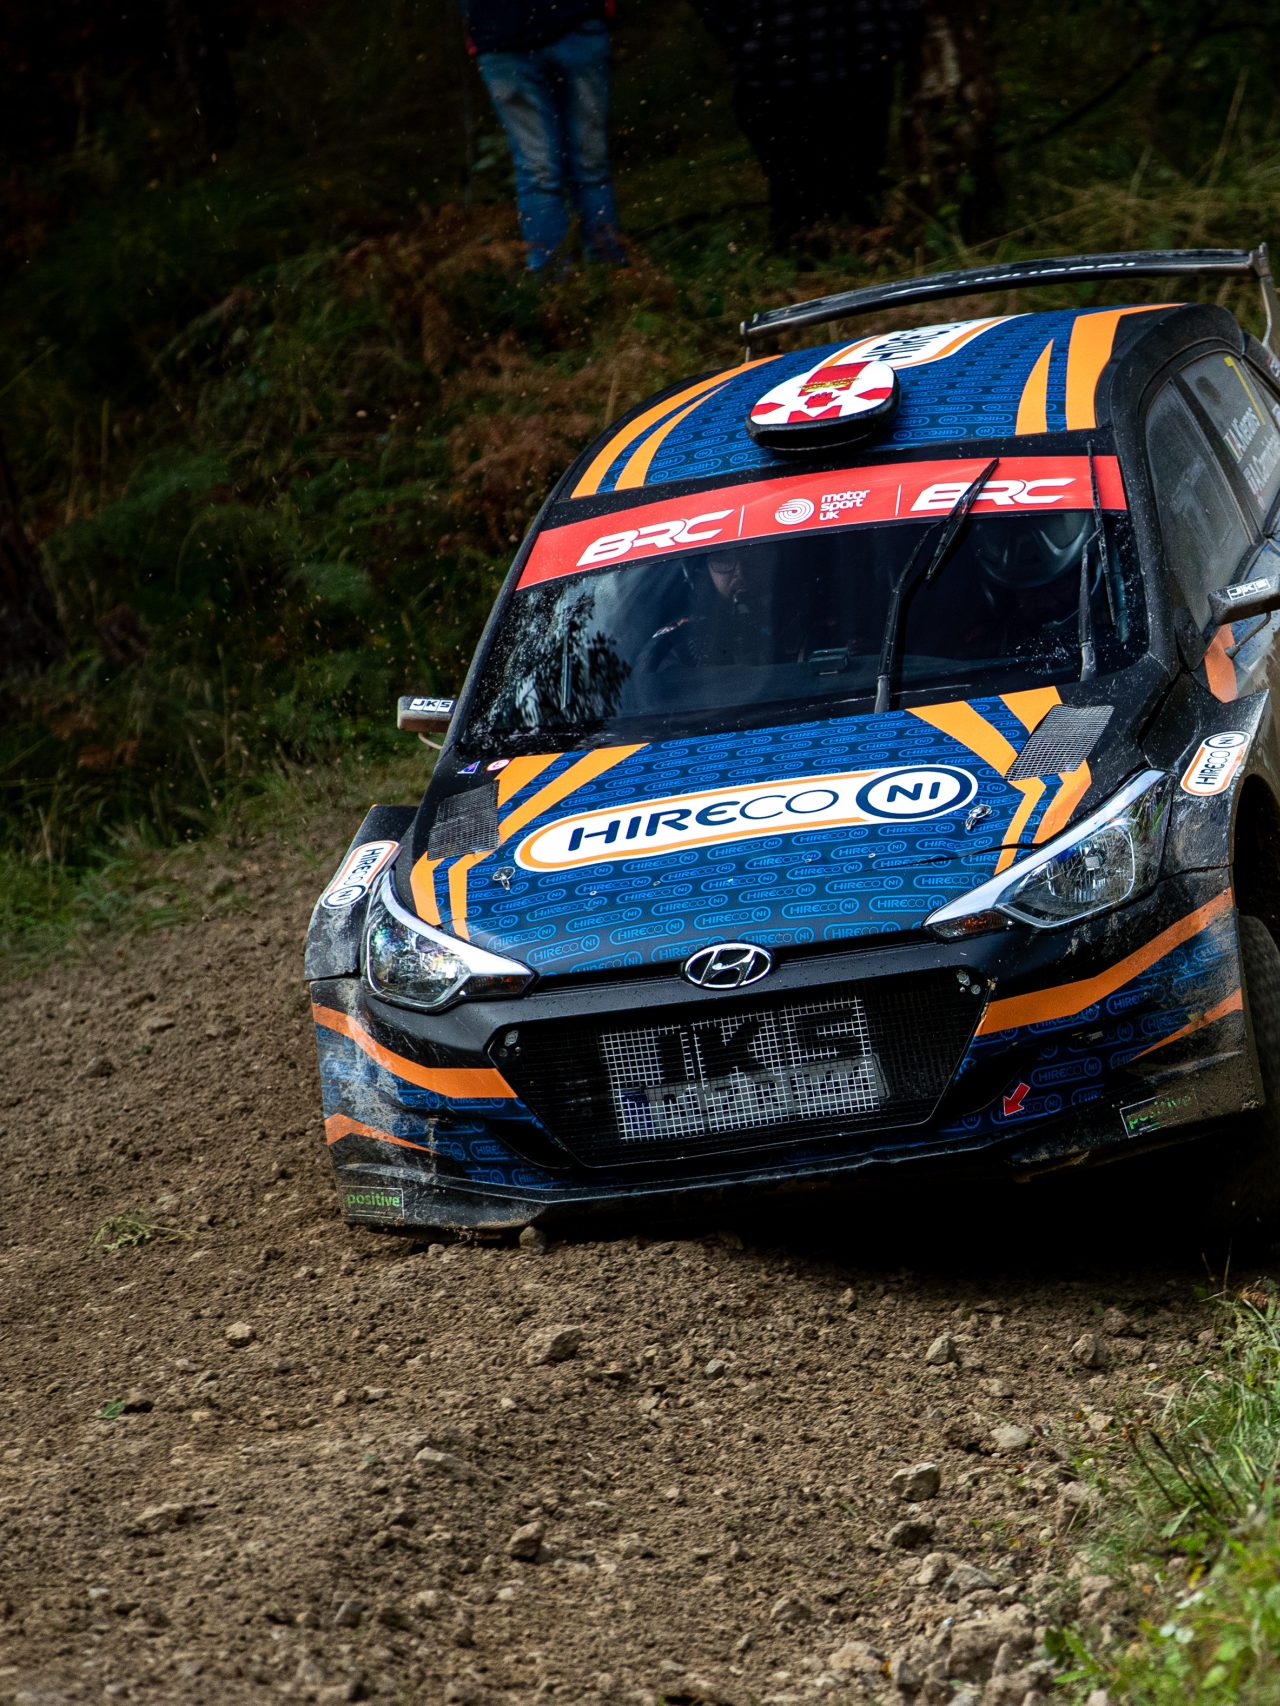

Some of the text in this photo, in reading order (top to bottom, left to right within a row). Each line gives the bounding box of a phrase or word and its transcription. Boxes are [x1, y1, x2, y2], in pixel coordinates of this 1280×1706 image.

[821, 490, 870, 503] motor
[910, 478, 1076, 511] BRC
[821, 499, 864, 511] sport
[819, 511, 839, 520] UK
[576, 509, 735, 566] BRC
[1229, 580, 1270, 598] JKS
[411, 699, 451, 709] JKS
[1195, 736, 1235, 786] HIRECO NI
[567, 781, 941, 851] HIRECO NI
[970, 855, 998, 864] HIRE
[336, 847, 384, 901] HIRECO NI
[790, 903, 836, 914] HIRECO
[878, 900, 924, 908] HIRECO
[702, 911, 748, 925] HIRECO
[347, 1192, 400, 1207] positive
